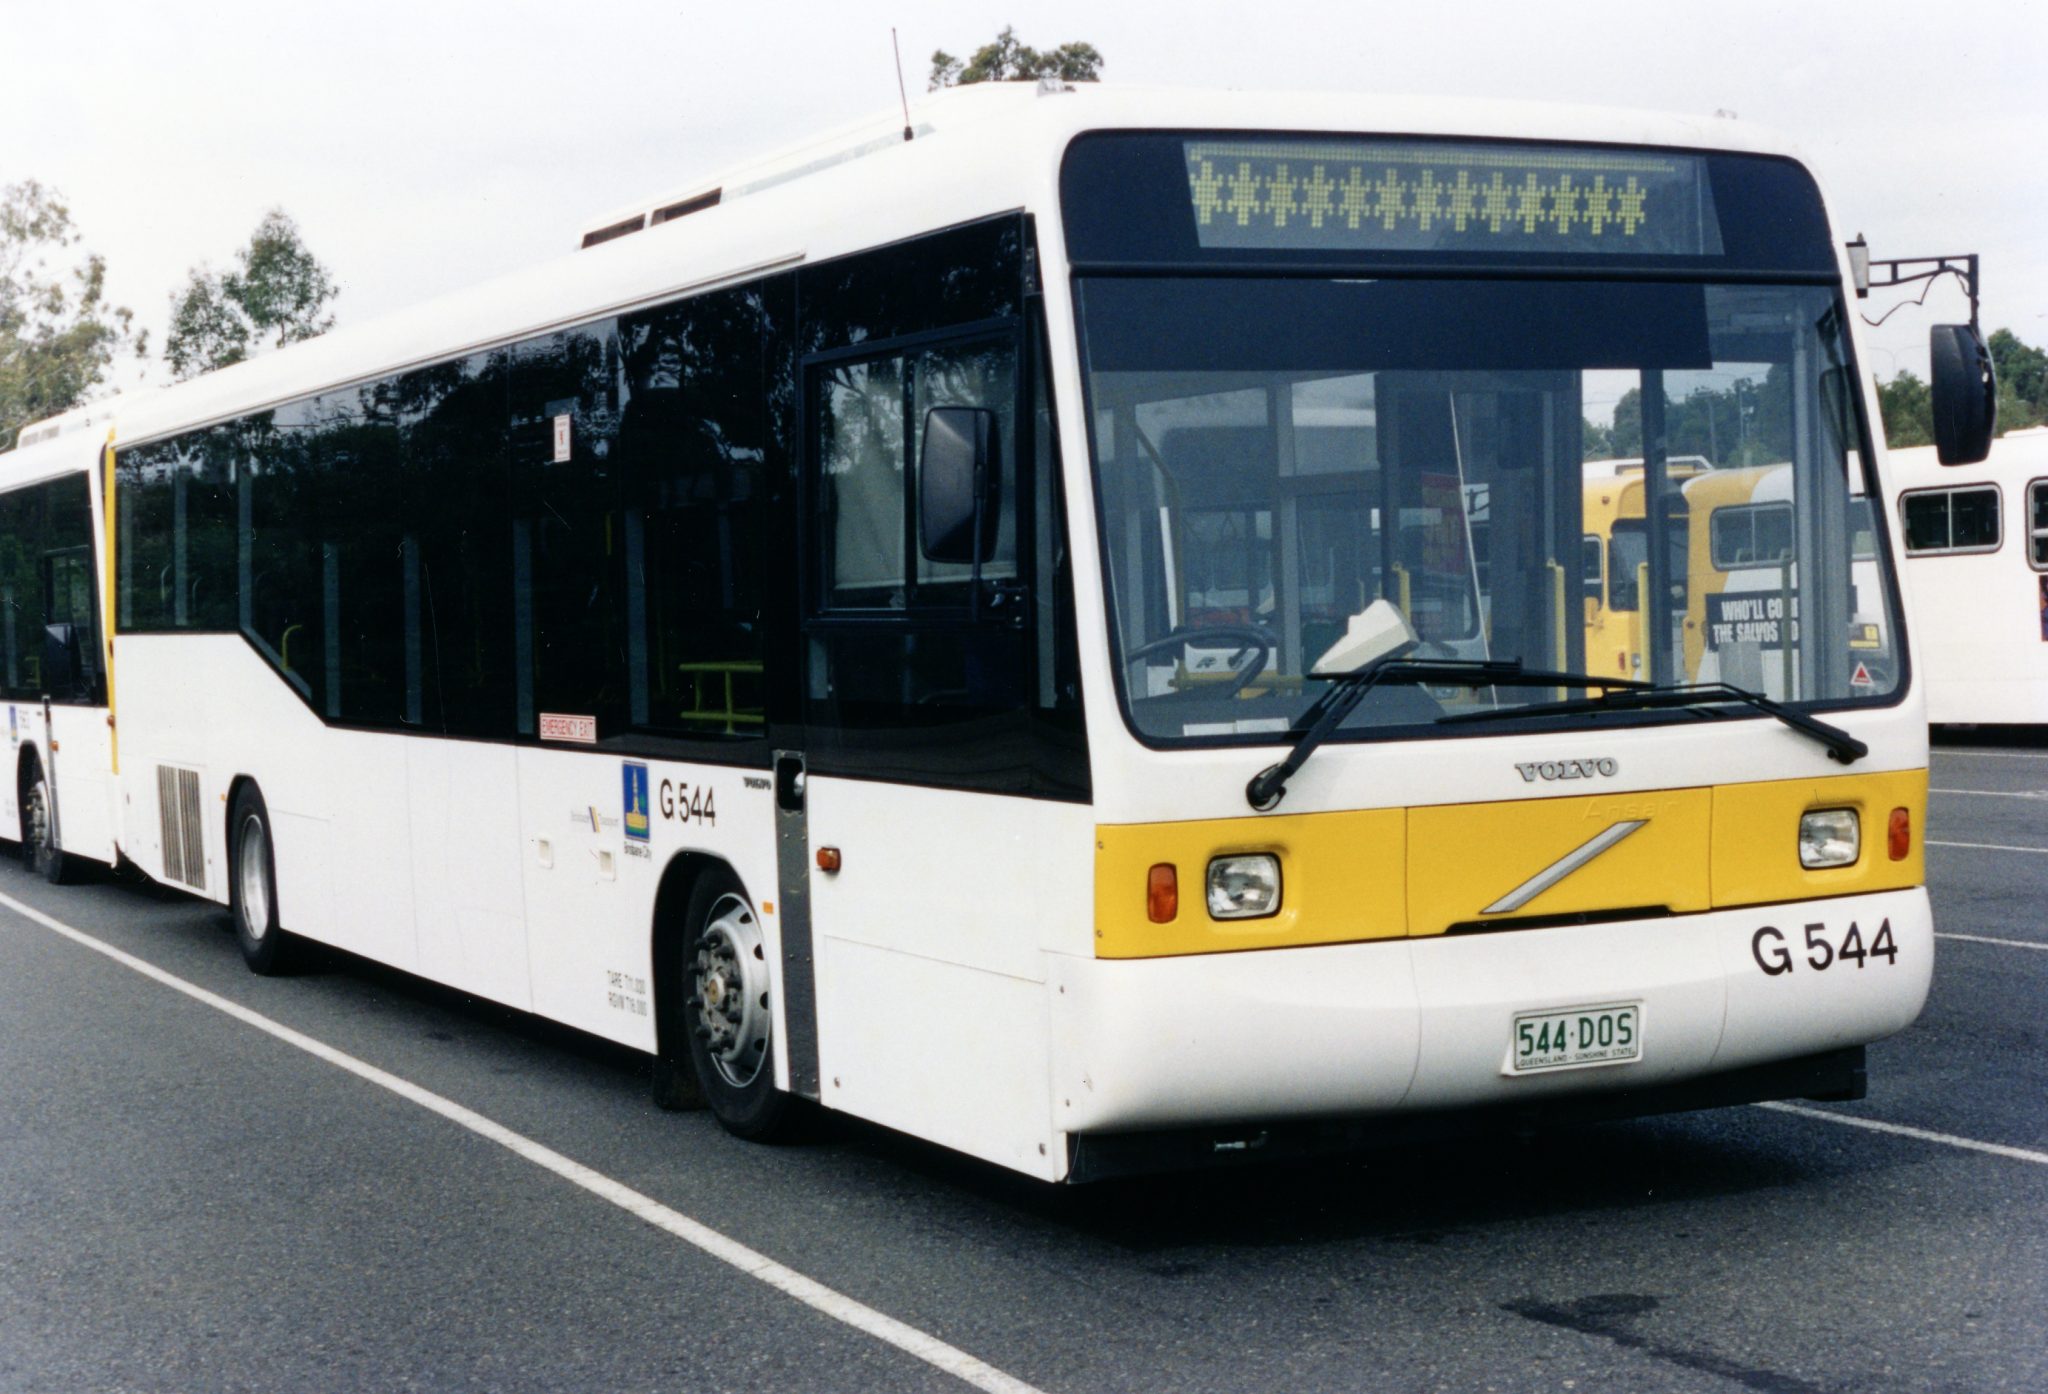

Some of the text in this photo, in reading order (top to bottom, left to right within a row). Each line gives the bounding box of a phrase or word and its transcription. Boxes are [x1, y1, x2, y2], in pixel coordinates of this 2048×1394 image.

[1721, 598, 1765, 622] WHO'LL
[1713, 624, 1734, 644] THE
[1736, 621, 1779, 643] SALVOS
[542, 718, 593, 737] EMERGENCY EXIT
[1514, 757, 1619, 782] VOLVO
[679, 782, 716, 827] 544
[1751, 917, 1899, 976] G 544
[1519, 1055, 1568, 1067] QUEENSLAND
[1575, 1050, 1607, 1060] SUNSHINE
[1612, 1047, 1632, 1057] STATE
